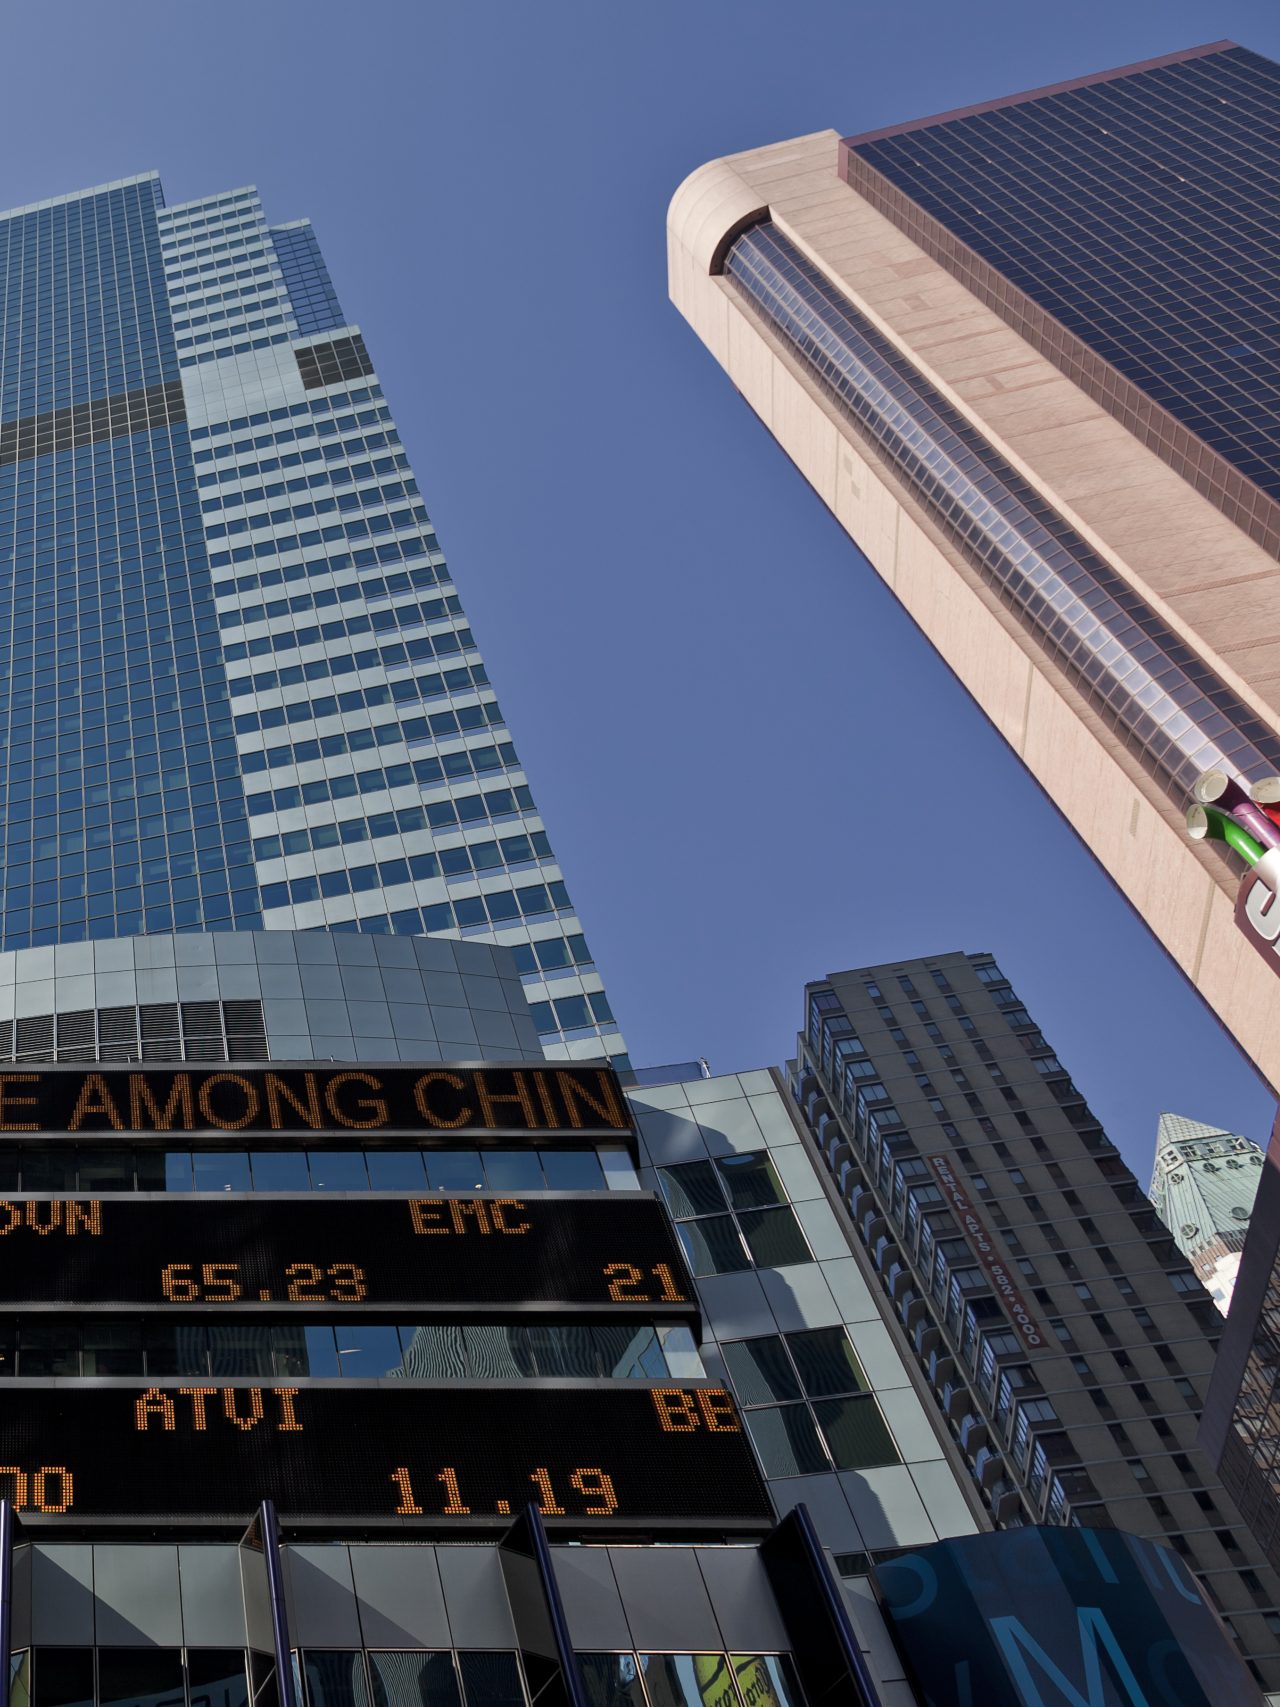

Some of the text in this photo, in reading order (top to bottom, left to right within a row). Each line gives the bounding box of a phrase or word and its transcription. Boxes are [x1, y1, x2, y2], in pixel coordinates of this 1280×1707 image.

[67, 1071, 389, 1131] AMONG
[411, 1069, 629, 1130] CHIN
[408, 1198, 533, 1235] EMC
[931, 1156, 968, 1211] RENTAL
[965, 1214, 991, 1252] APTS
[160, 1263, 368, 1302] 65.23
[602, 1262, 689, 1302] 21
[133, 1386, 305, 1431] ATVI
[389, 1466, 619, 1515] 11.19
